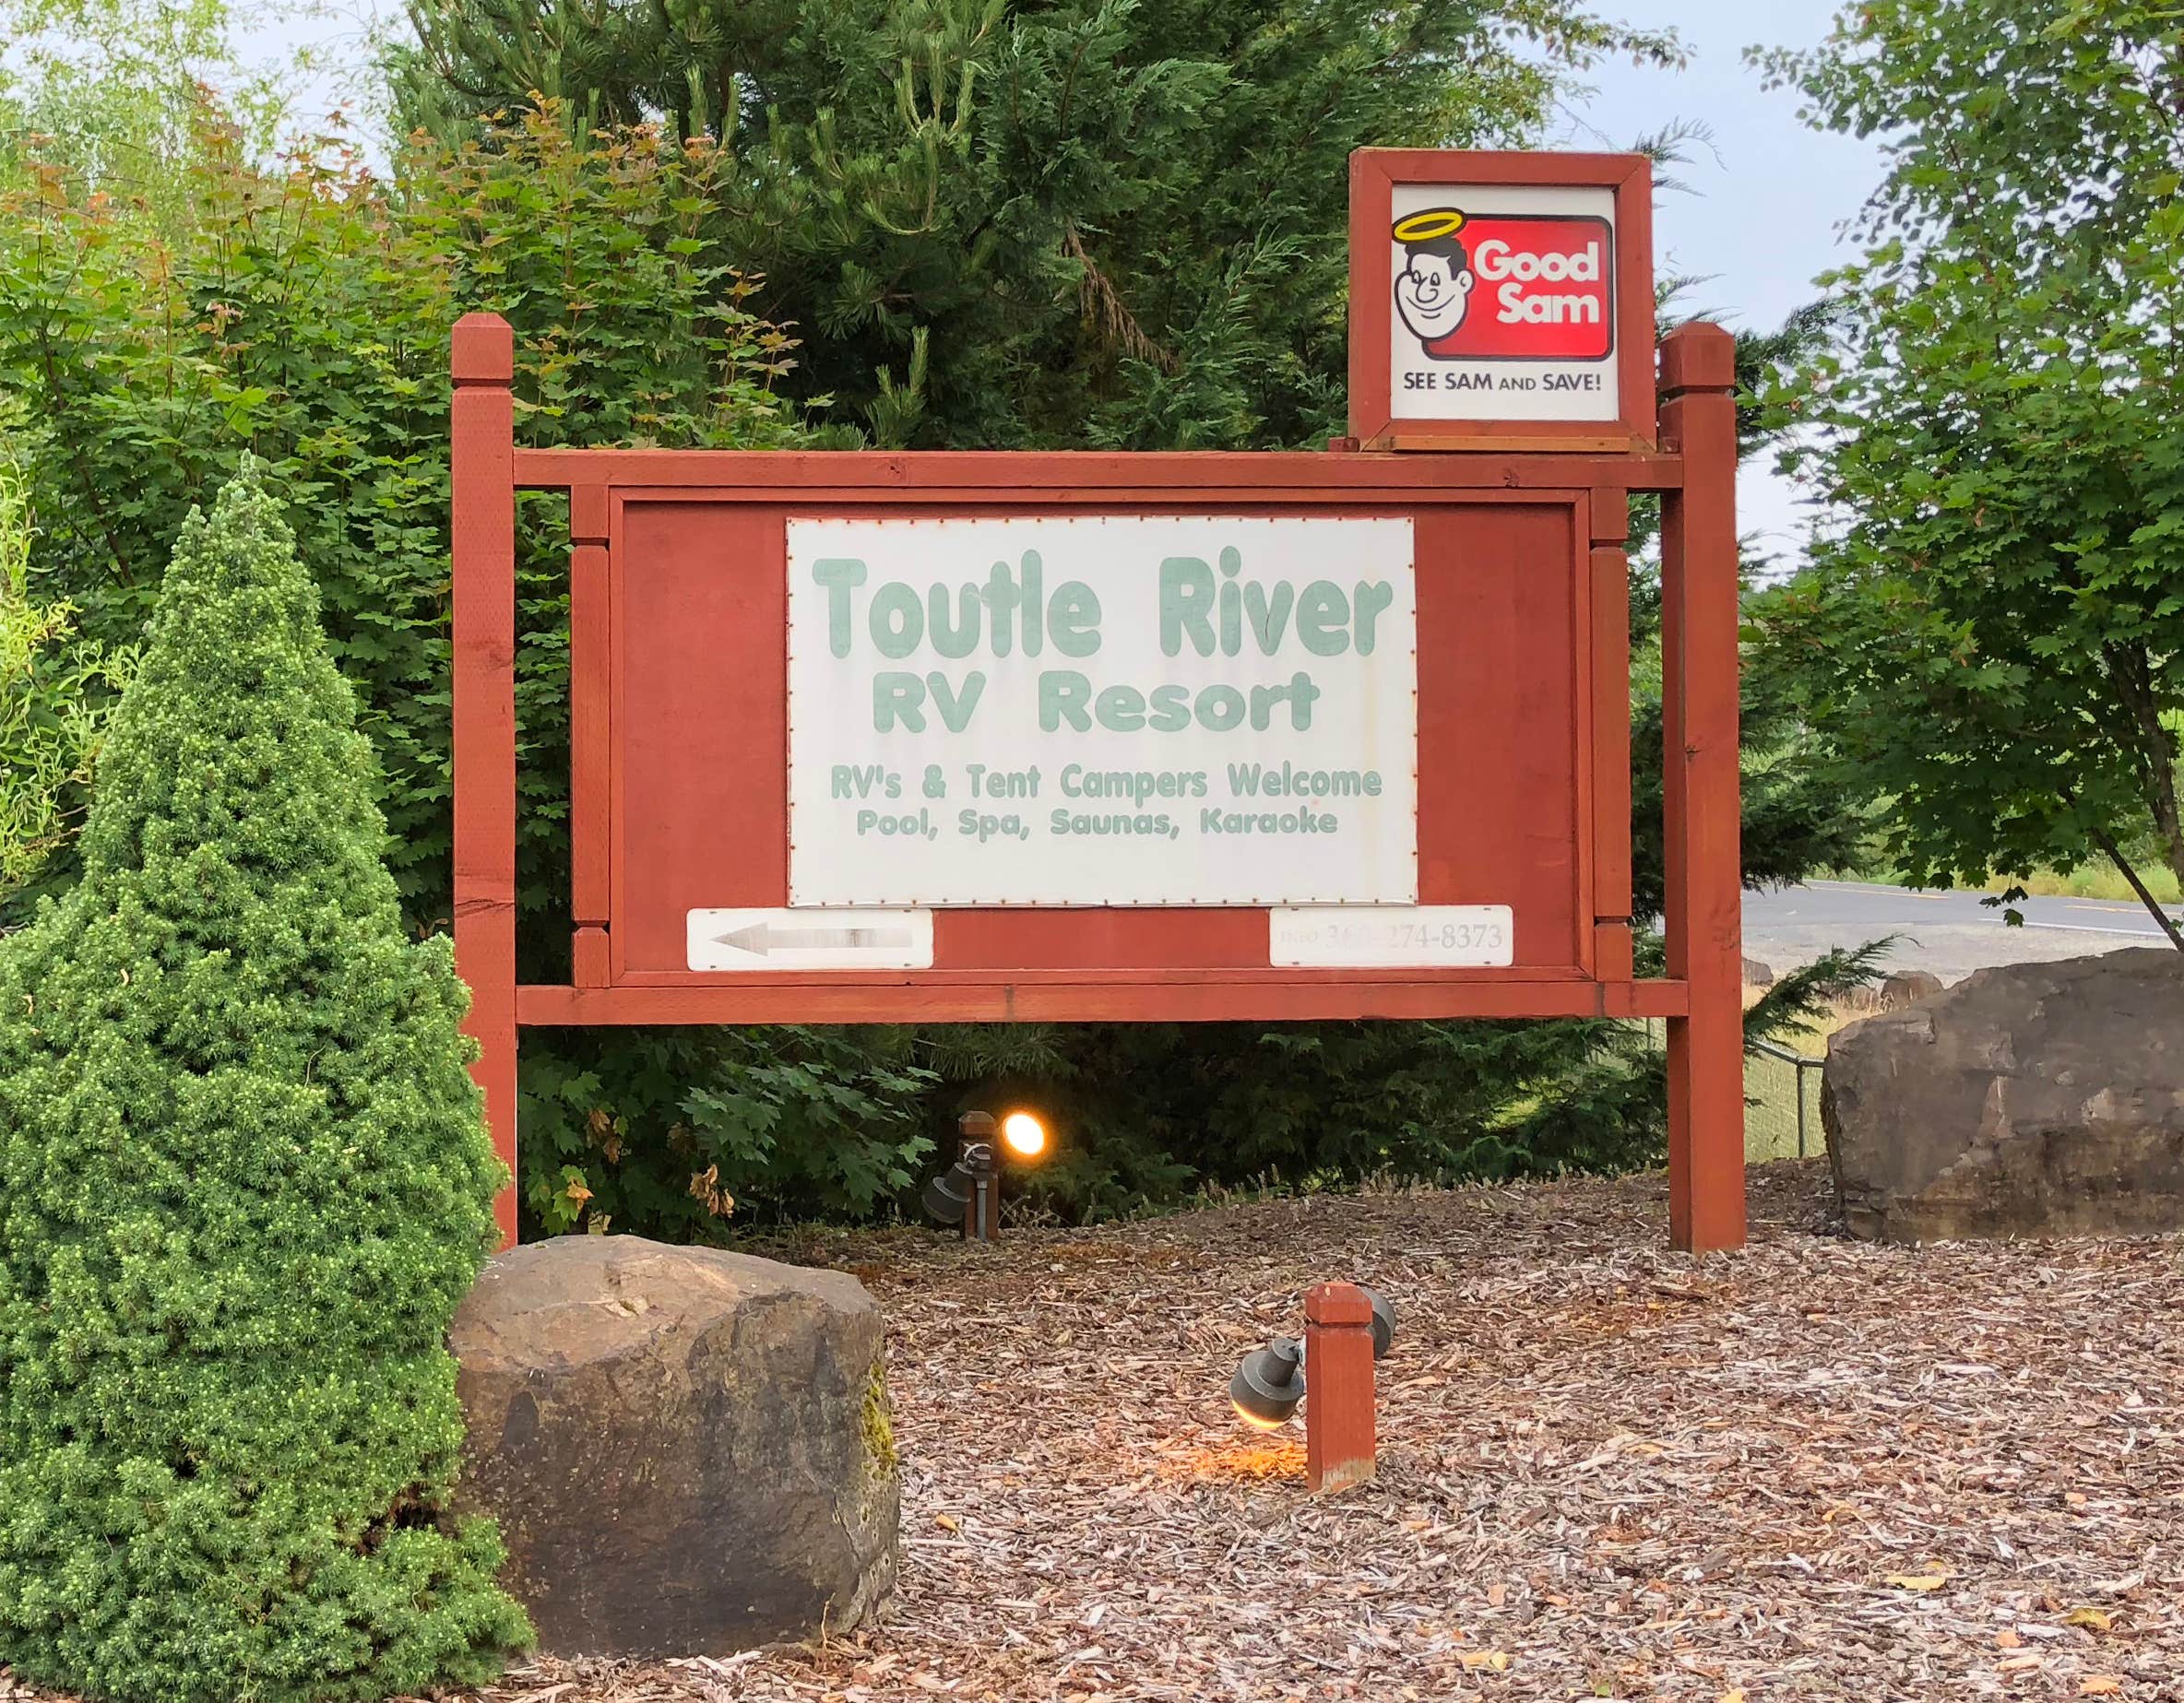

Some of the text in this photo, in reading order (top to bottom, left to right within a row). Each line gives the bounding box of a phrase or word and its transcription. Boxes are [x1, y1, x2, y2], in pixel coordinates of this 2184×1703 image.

[1474, 239, 1598, 281] Good
[1496, 282, 1599, 324] Sam
[1404, 372, 1601, 391] SEE SAM AND SAVE!
[813, 546, 1394, 658] Toutle River
[872, 670, 1321, 733] RV Resort
[831, 761, 1383, 808] RV's & Tent Campers Welcome
[858, 806, 1338, 843] Pool, Spa, Saunas, Karaoke
